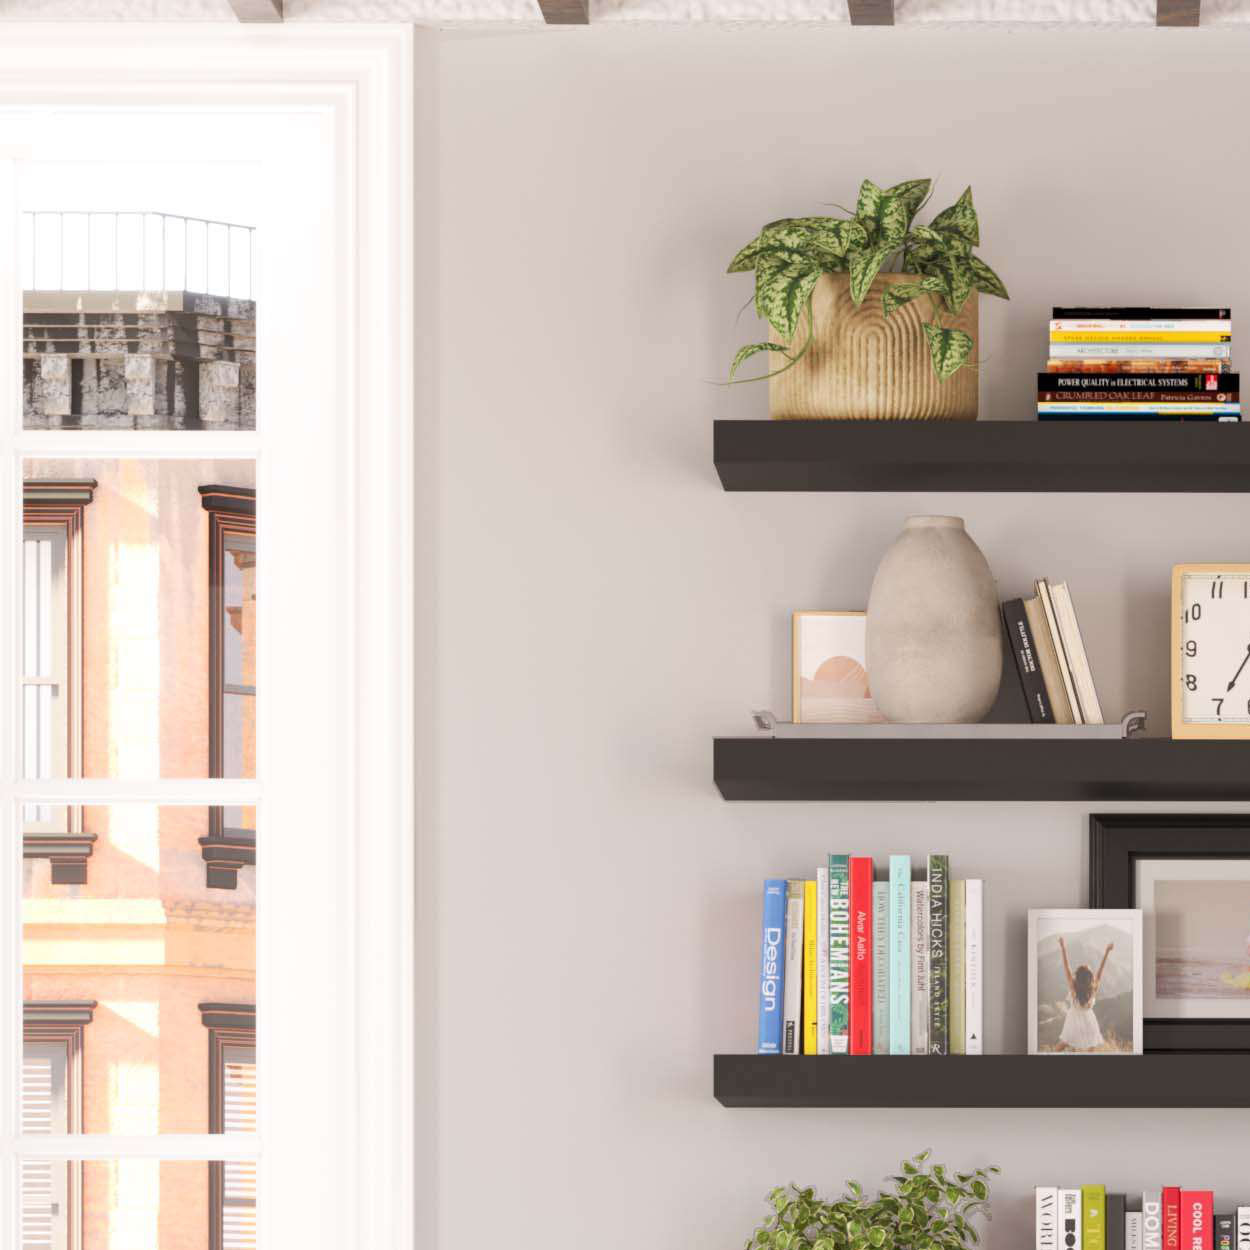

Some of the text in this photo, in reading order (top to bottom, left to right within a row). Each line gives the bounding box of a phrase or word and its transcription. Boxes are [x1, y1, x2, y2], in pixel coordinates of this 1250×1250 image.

[1058, 378, 1080, 387] POWER
[1081, 378, 1110, 388] QUALITY
[1117, 378, 1156, 387] ELECTRICAL
[1158, 378, 1188, 387] SYSTEMS
[1185, 603, 1201, 624] 10
[1186, 640, 1197, 657] 9
[1186, 674, 1197, 691] 8
[1211, 699, 1224, 715] 7
[857, 912, 866, 933] Alvar
[931, 868, 942, 958] INDIA HICKS
[830, 899, 848, 1004] BOHEMIANS
[764, 928, 781, 1011] Design
[1167, 1205, 1177, 1246] LIVING
[1192, 1203, 1202, 1233] COOL
